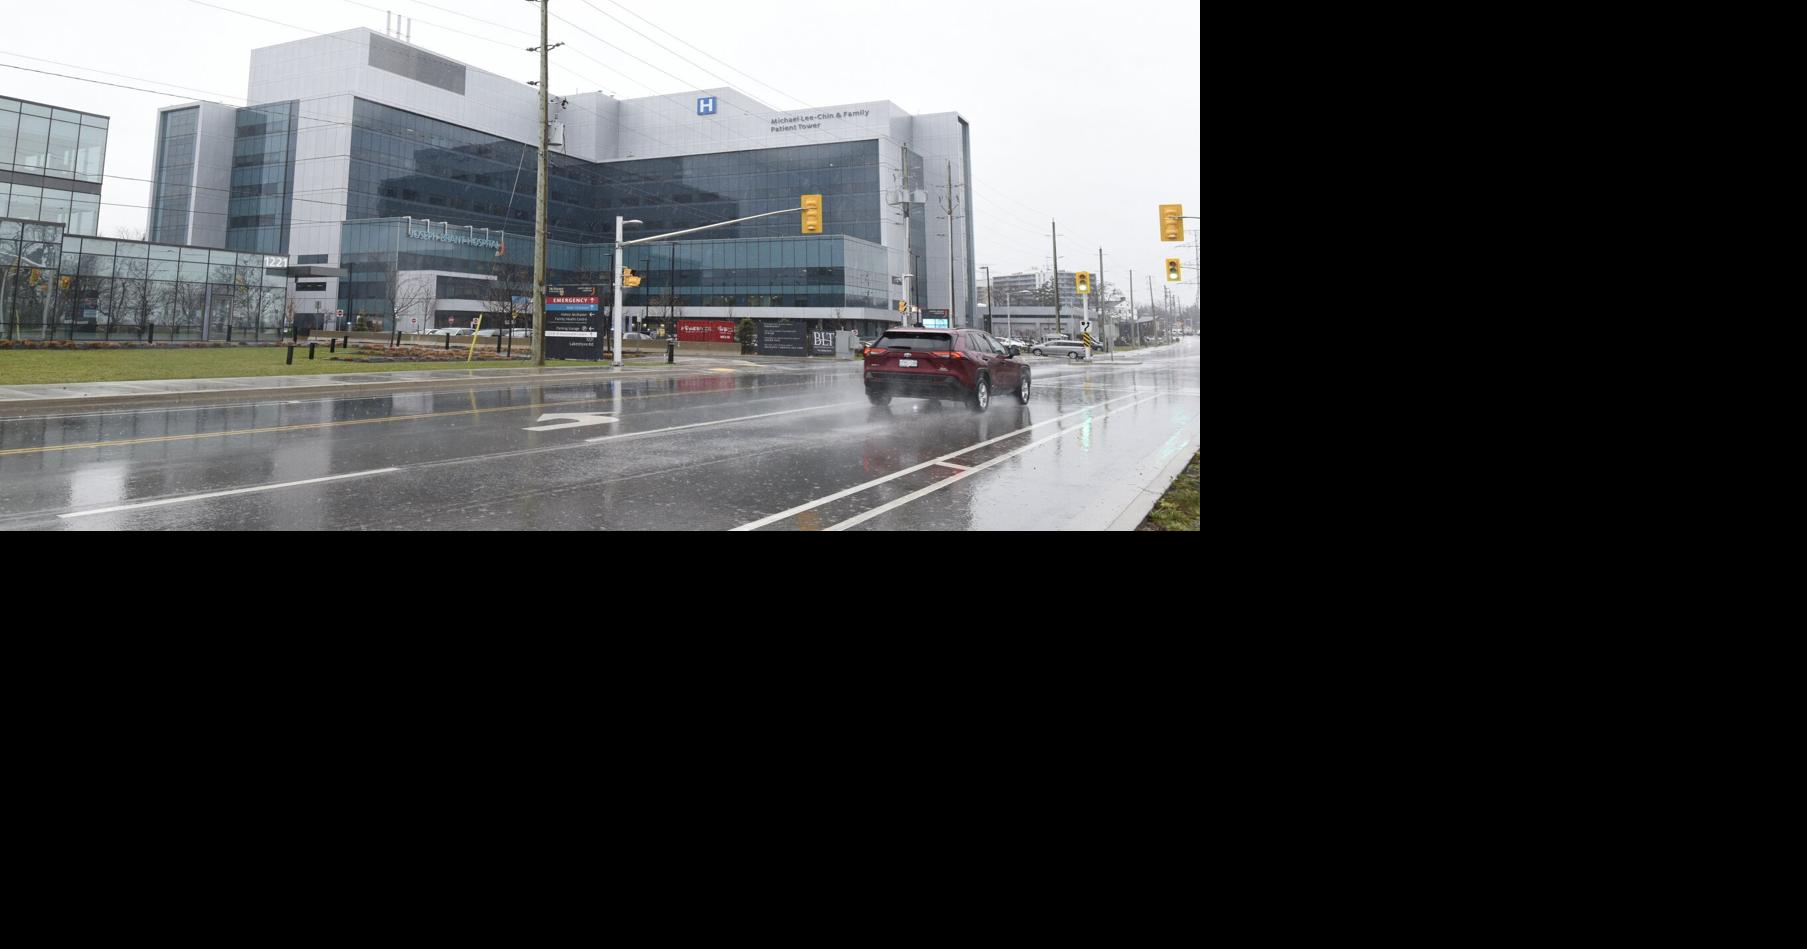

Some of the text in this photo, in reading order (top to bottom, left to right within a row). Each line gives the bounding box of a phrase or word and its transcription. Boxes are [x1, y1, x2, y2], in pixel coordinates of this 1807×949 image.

[700, 98, 713, 113] H
[770, 115, 799, 124] Michael
[800, 113, 835, 122] Lee-Chin
[843, 109, 870, 119] Family
[770, 122, 821, 133] Patient Tower
[265, 256, 288, 268] 1221
[813, 331, 836, 347] BLT
